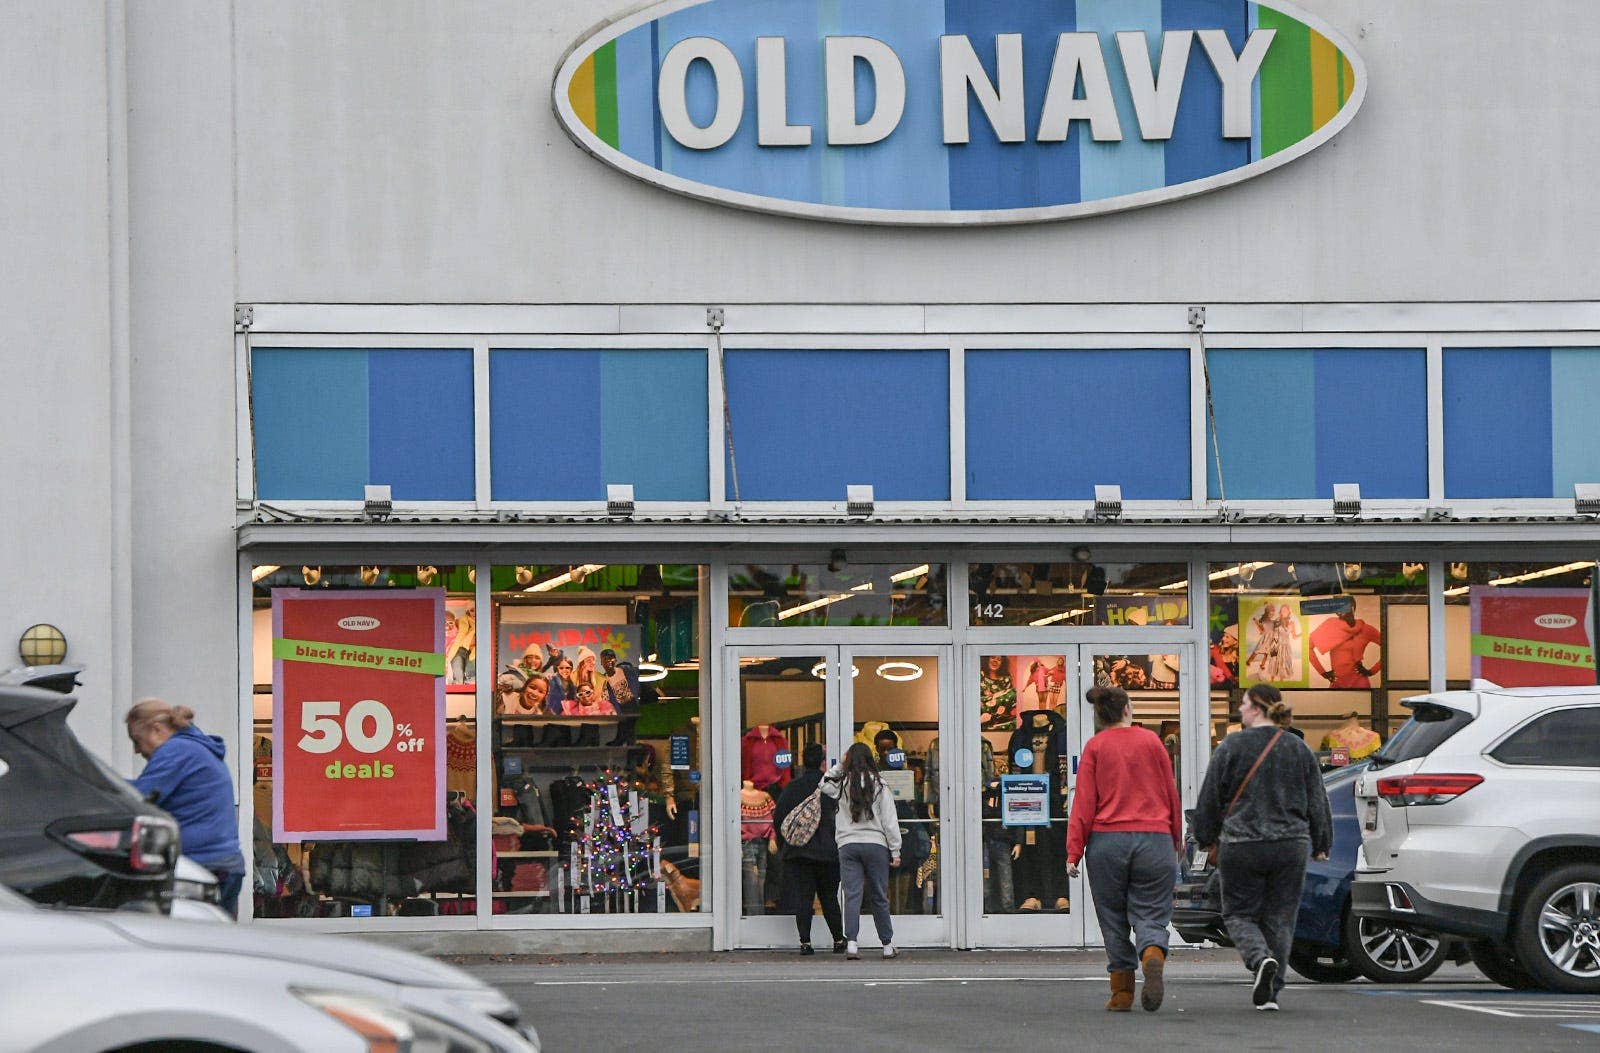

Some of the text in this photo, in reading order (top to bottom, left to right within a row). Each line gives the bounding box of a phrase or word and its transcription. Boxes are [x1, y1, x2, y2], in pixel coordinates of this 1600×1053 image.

[658, 29, 1277, 150] OLD NAVY
[974, 603, 1003, 617] 142
[508, 626, 612, 652] HOLIDAY
[296, 645, 422, 668] black friday sale!
[1493, 641, 1532, 656] black
[1537, 647, 1580, 663] friday
[396, 738, 425, 752] off
[775, 753, 792, 764] OUT
[888, 752, 905, 763] OUT
[325, 760, 395, 779] deals
